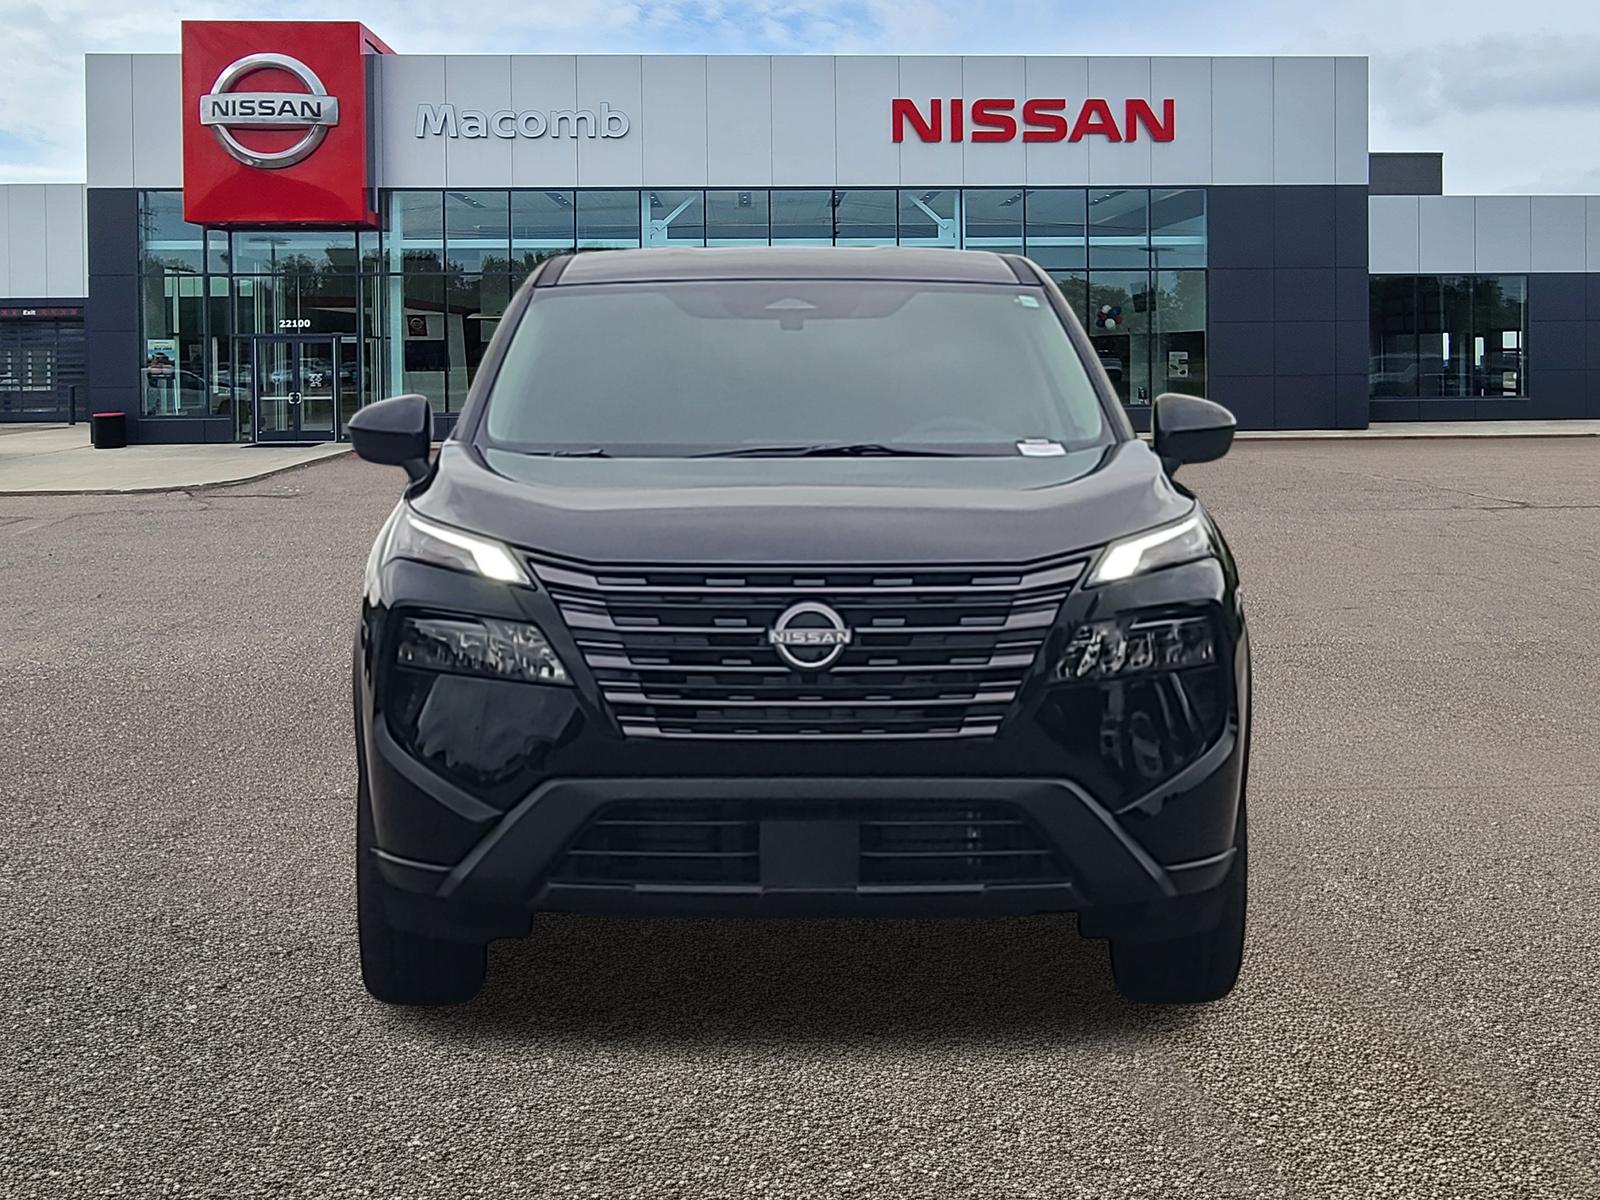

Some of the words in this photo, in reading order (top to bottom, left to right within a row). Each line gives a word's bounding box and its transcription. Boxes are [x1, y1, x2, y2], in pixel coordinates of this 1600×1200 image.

[211, 100, 322, 118] NISSAN
[415, 101, 630, 139] Macomb
[892, 98, 1175, 142] NISSAN
[279, 319, 311, 328] 22100
[768, 629, 851, 644] NISSAN
